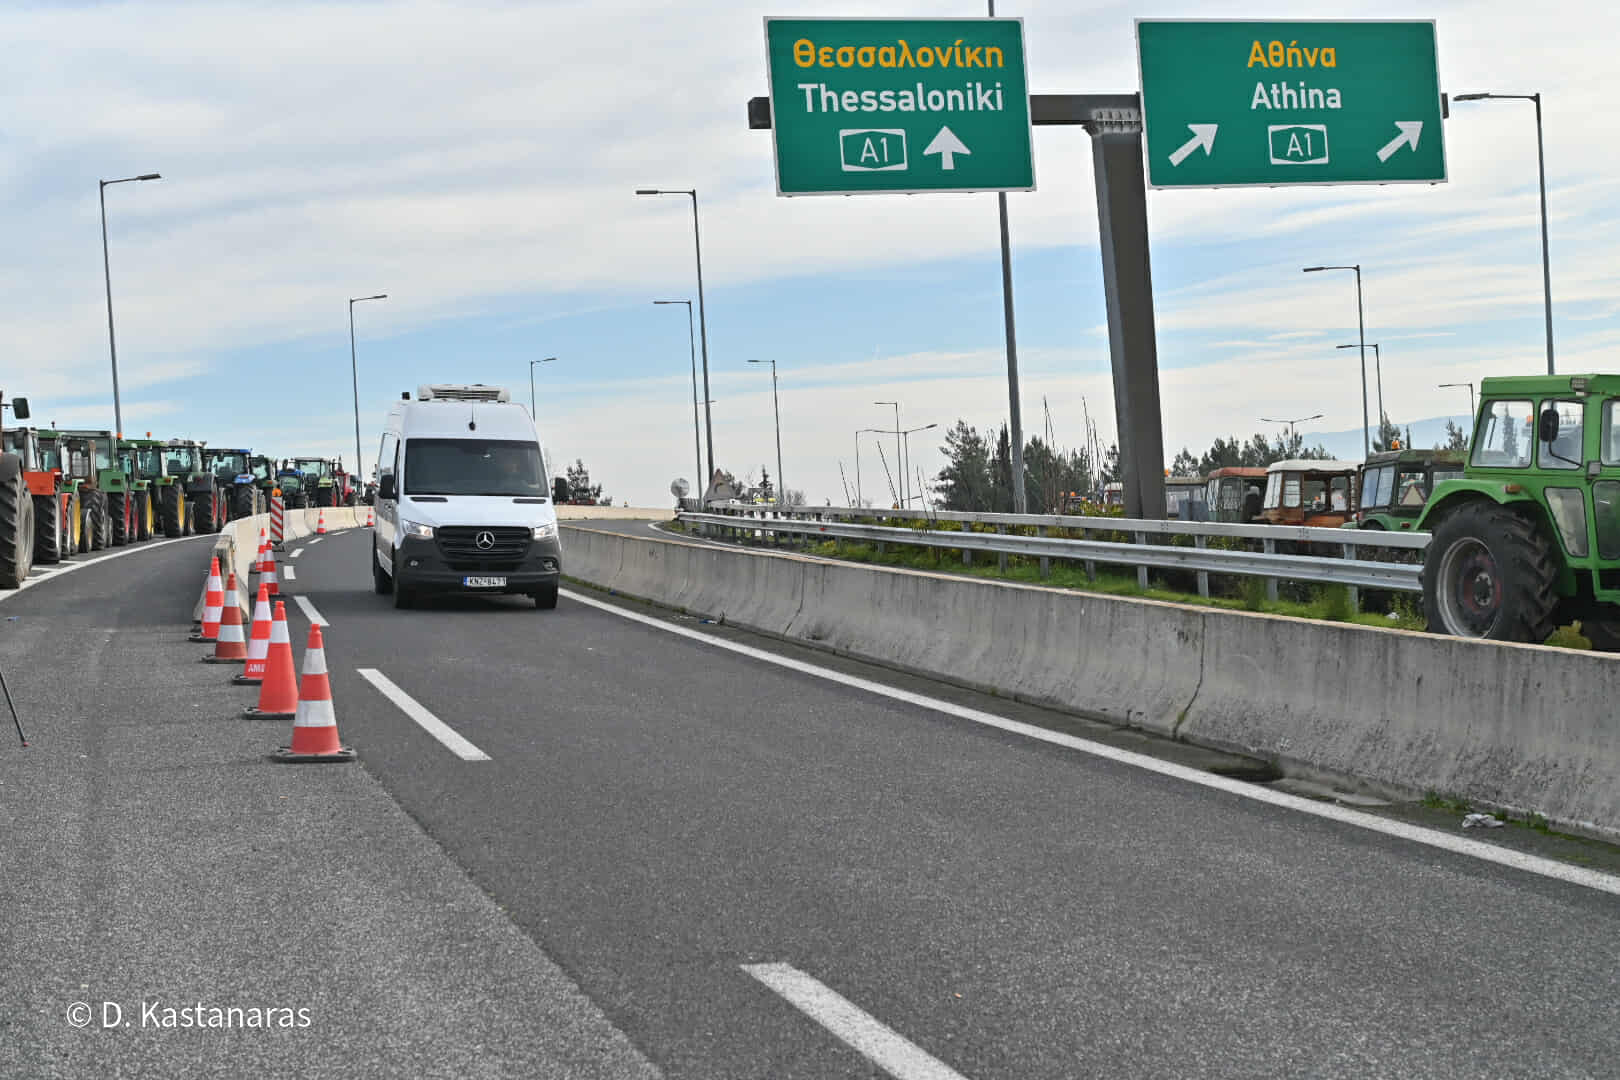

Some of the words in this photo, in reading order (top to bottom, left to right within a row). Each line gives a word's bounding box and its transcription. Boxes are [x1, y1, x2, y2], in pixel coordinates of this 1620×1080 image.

[793, 38, 1004, 68] Θεσσαλονίκη
[1247, 40, 1336, 68] Αθήνα
[797, 82, 1003, 113] Thessaloniki
[1250, 81, 1342, 110] Athina
[860, 136, 889, 163] A1
[1286, 132, 1312, 157] A1
